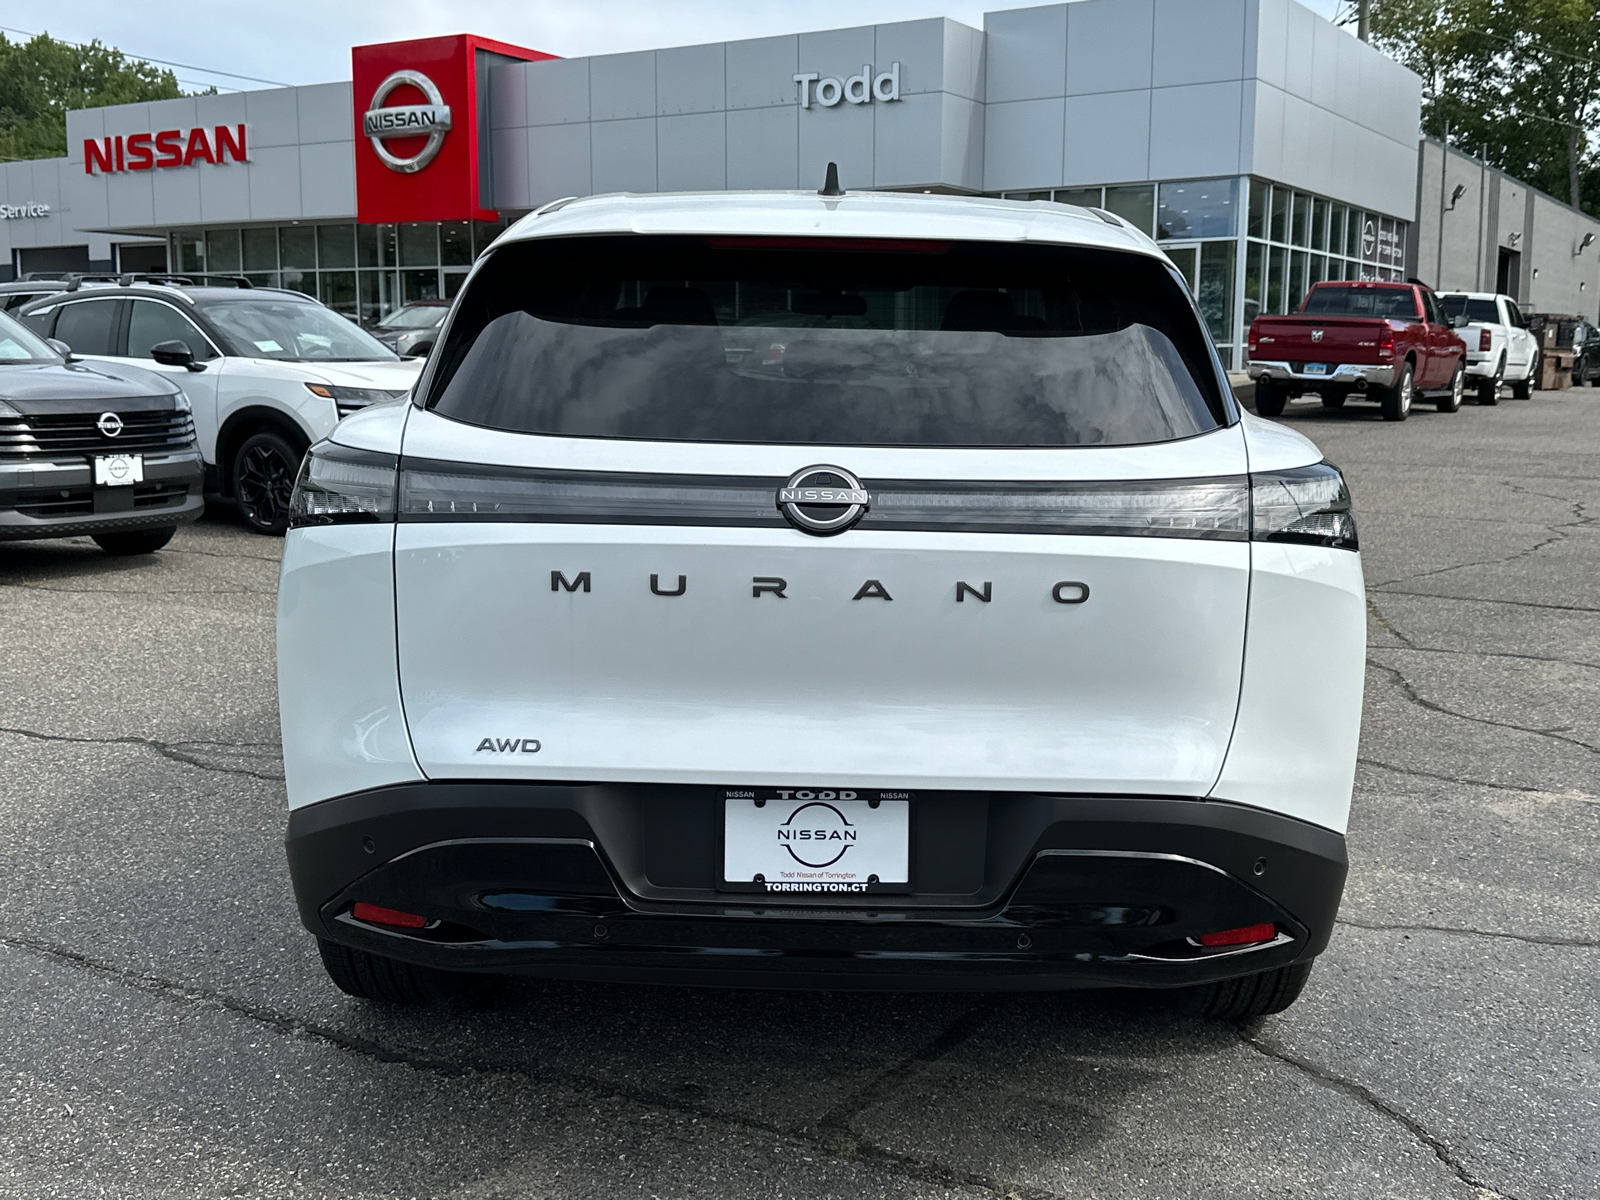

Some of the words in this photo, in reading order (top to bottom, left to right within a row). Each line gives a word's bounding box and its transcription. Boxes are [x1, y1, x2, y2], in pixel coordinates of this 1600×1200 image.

[792, 61, 900, 109] Todd
[368, 111, 435, 131] NISSAN
[84, 124, 248, 174] NISSAN
[0, 201, 45, 219] Service
[781, 490, 864, 501] NISSAN
[551, 570, 1090, 604] MURANO
[476, 738, 541, 753] AWD
[776, 790, 857, 800] TODD
[777, 830, 857, 840] NISSAN
[796, 871, 816, 879] Nissan
[817, 871, 824, 879] of
[825, 871, 856, 879] Torrington
